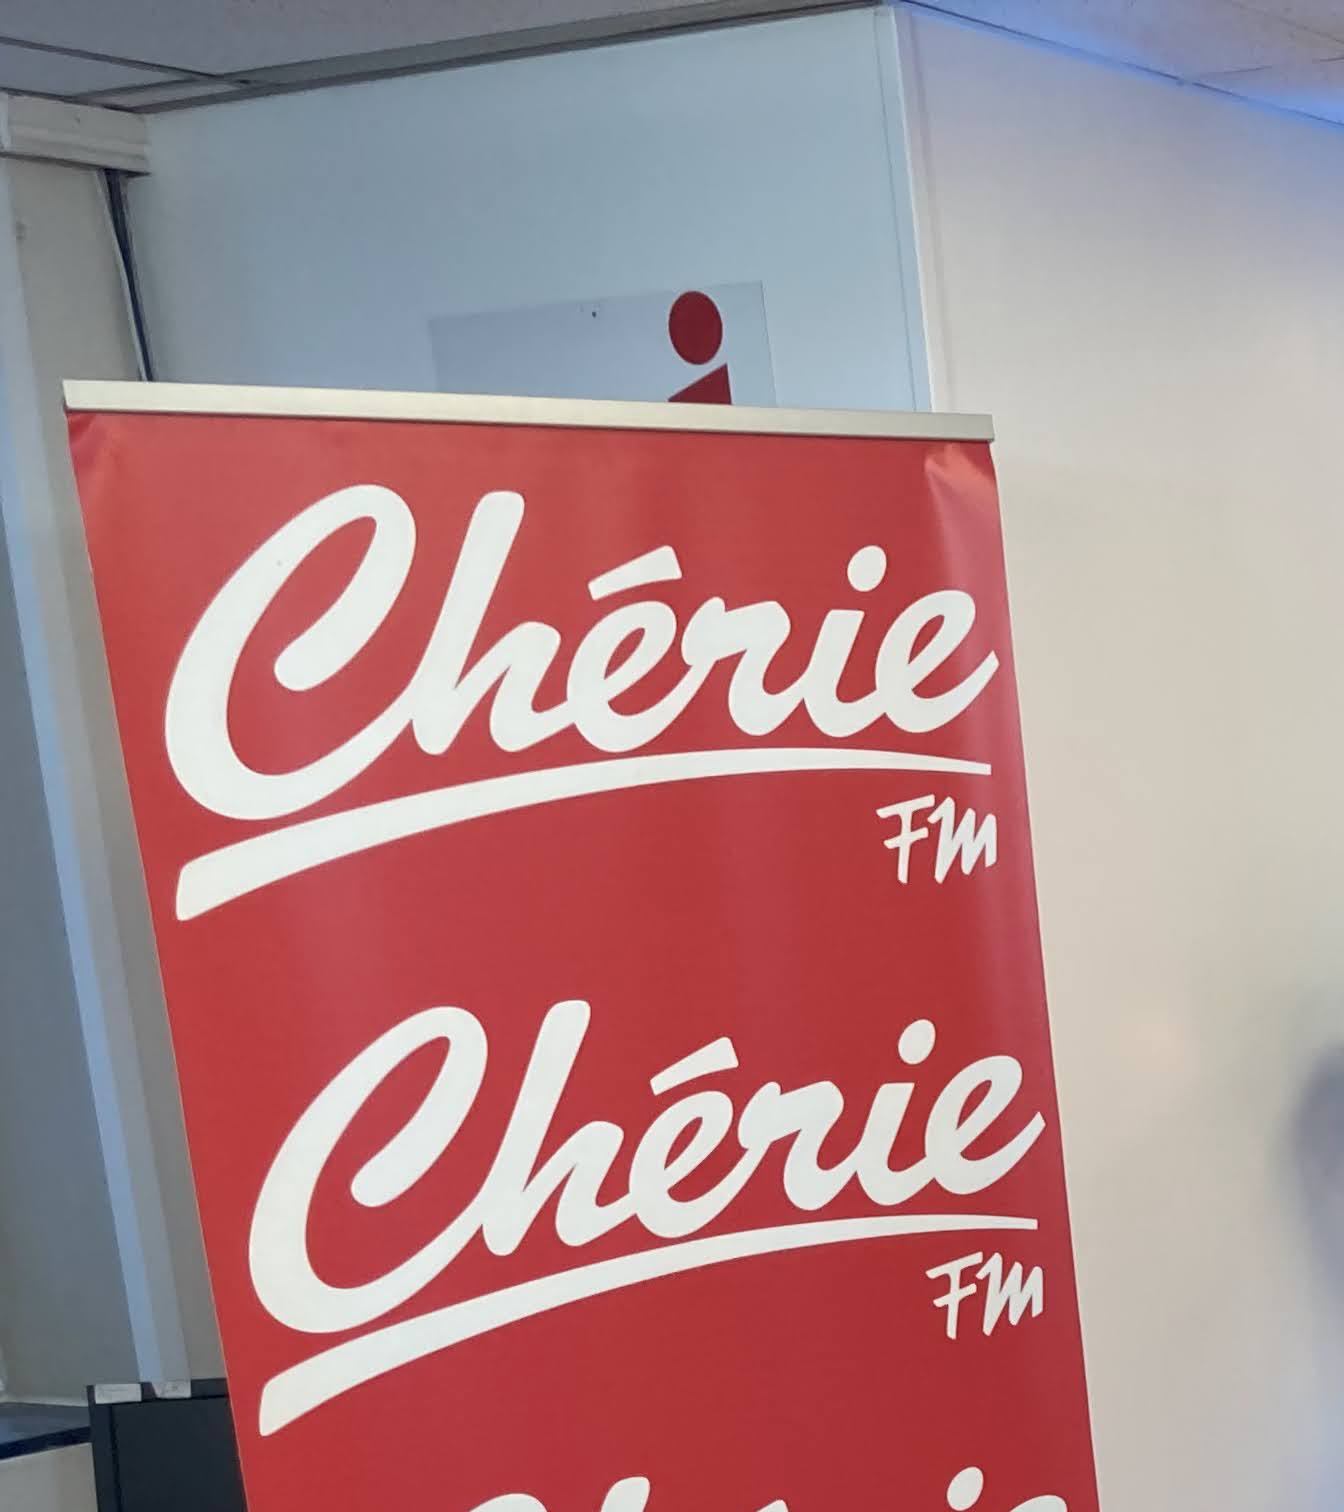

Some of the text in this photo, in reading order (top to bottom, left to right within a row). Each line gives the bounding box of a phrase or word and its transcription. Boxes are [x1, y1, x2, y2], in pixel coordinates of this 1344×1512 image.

[165, 484, 997, 820] Chérie
[876, 794, 997, 884] FM
[249, 999, 1045, 1333] Chérie
[926, 1251, 1043, 1339] FM
